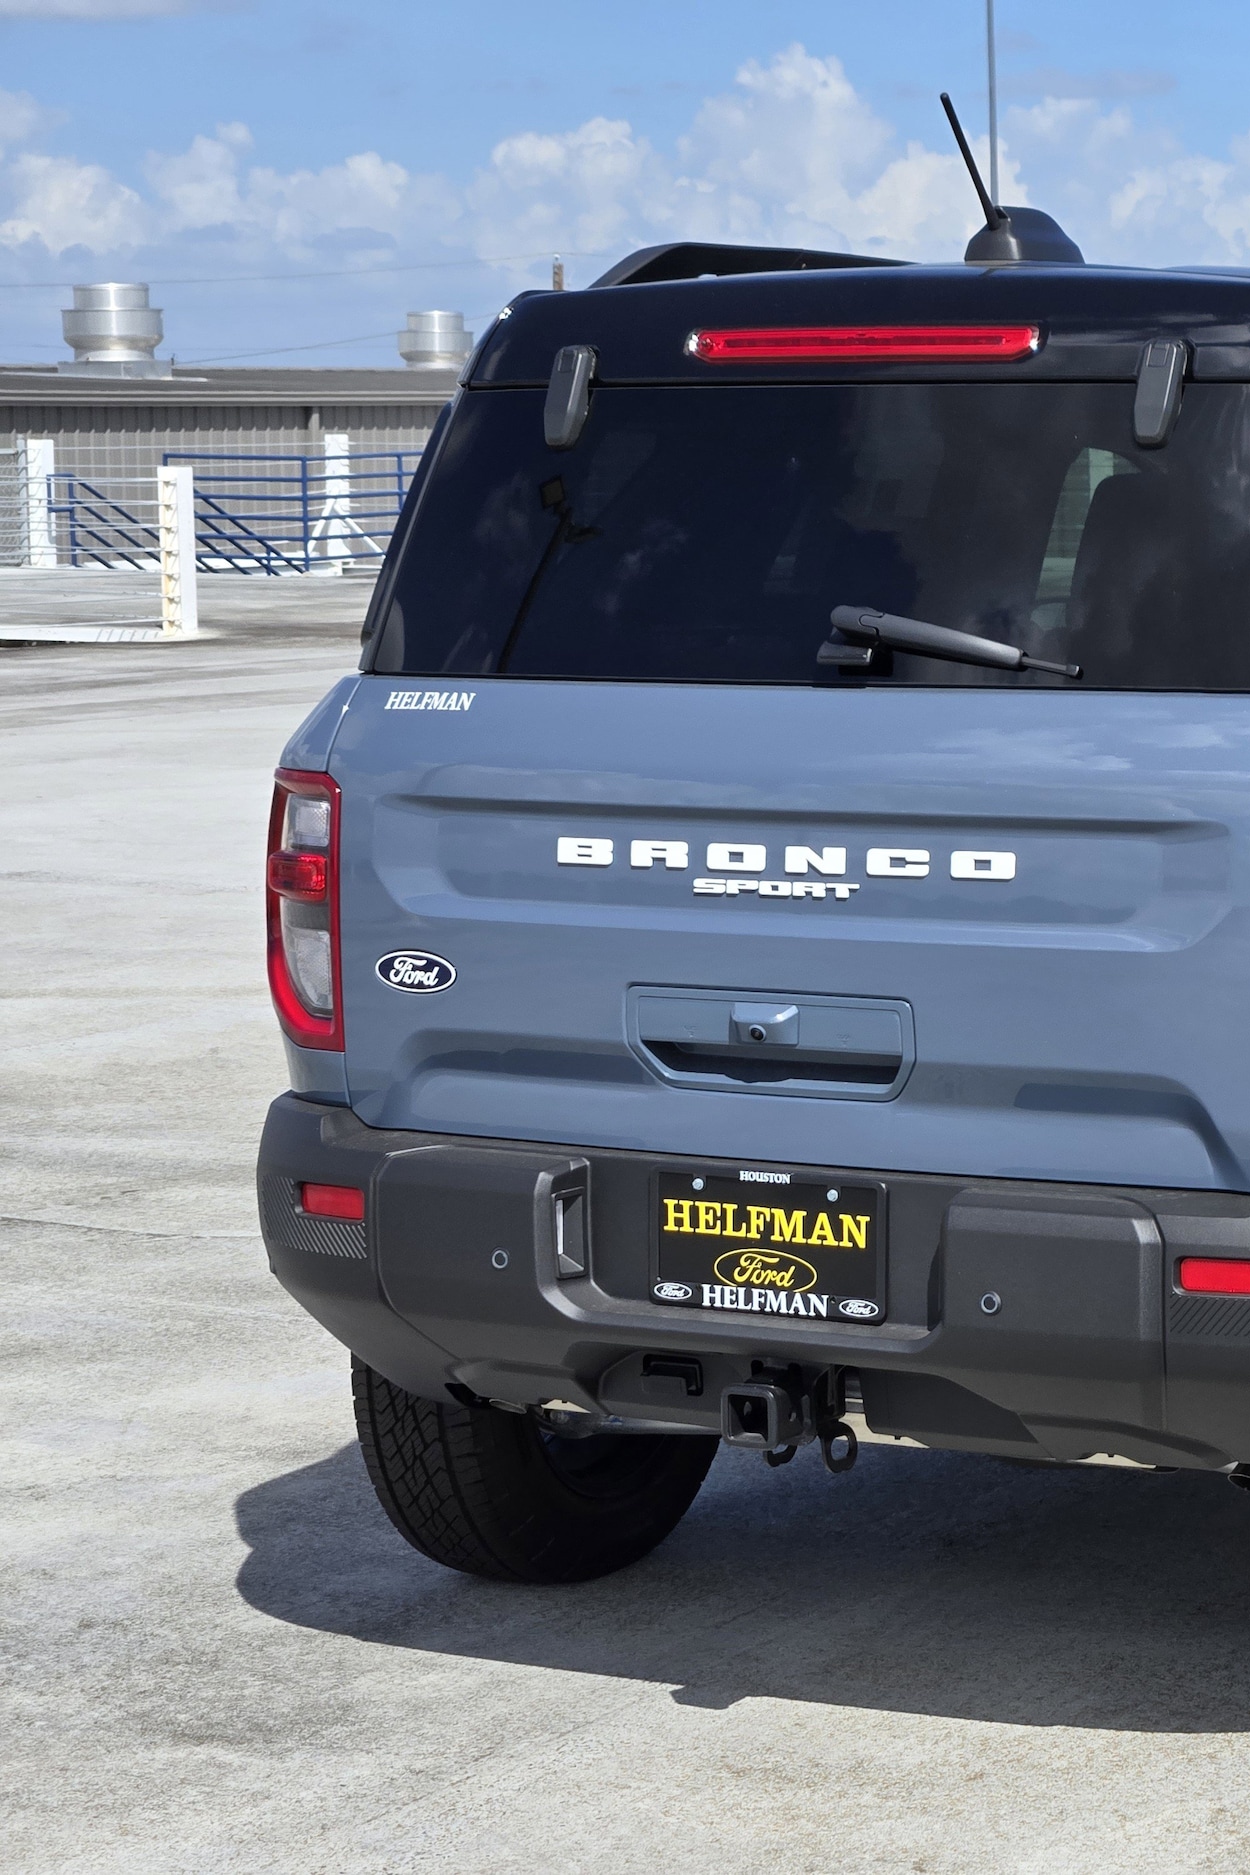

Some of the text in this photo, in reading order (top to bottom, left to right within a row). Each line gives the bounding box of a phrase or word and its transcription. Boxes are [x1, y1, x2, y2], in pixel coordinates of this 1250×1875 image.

[384, 691, 477, 711] HELFMAN
[556, 836, 1017, 880] BRONCO
[692, 878, 861, 899] SPORT
[389, 956, 440, 987] Ford
[739, 1170, 791, 1185] HOUSTON
[663, 1198, 870, 1249] HELFMAN
[733, 1253, 796, 1289] Ford
[700, 1283, 830, 1319] HELFMAN
